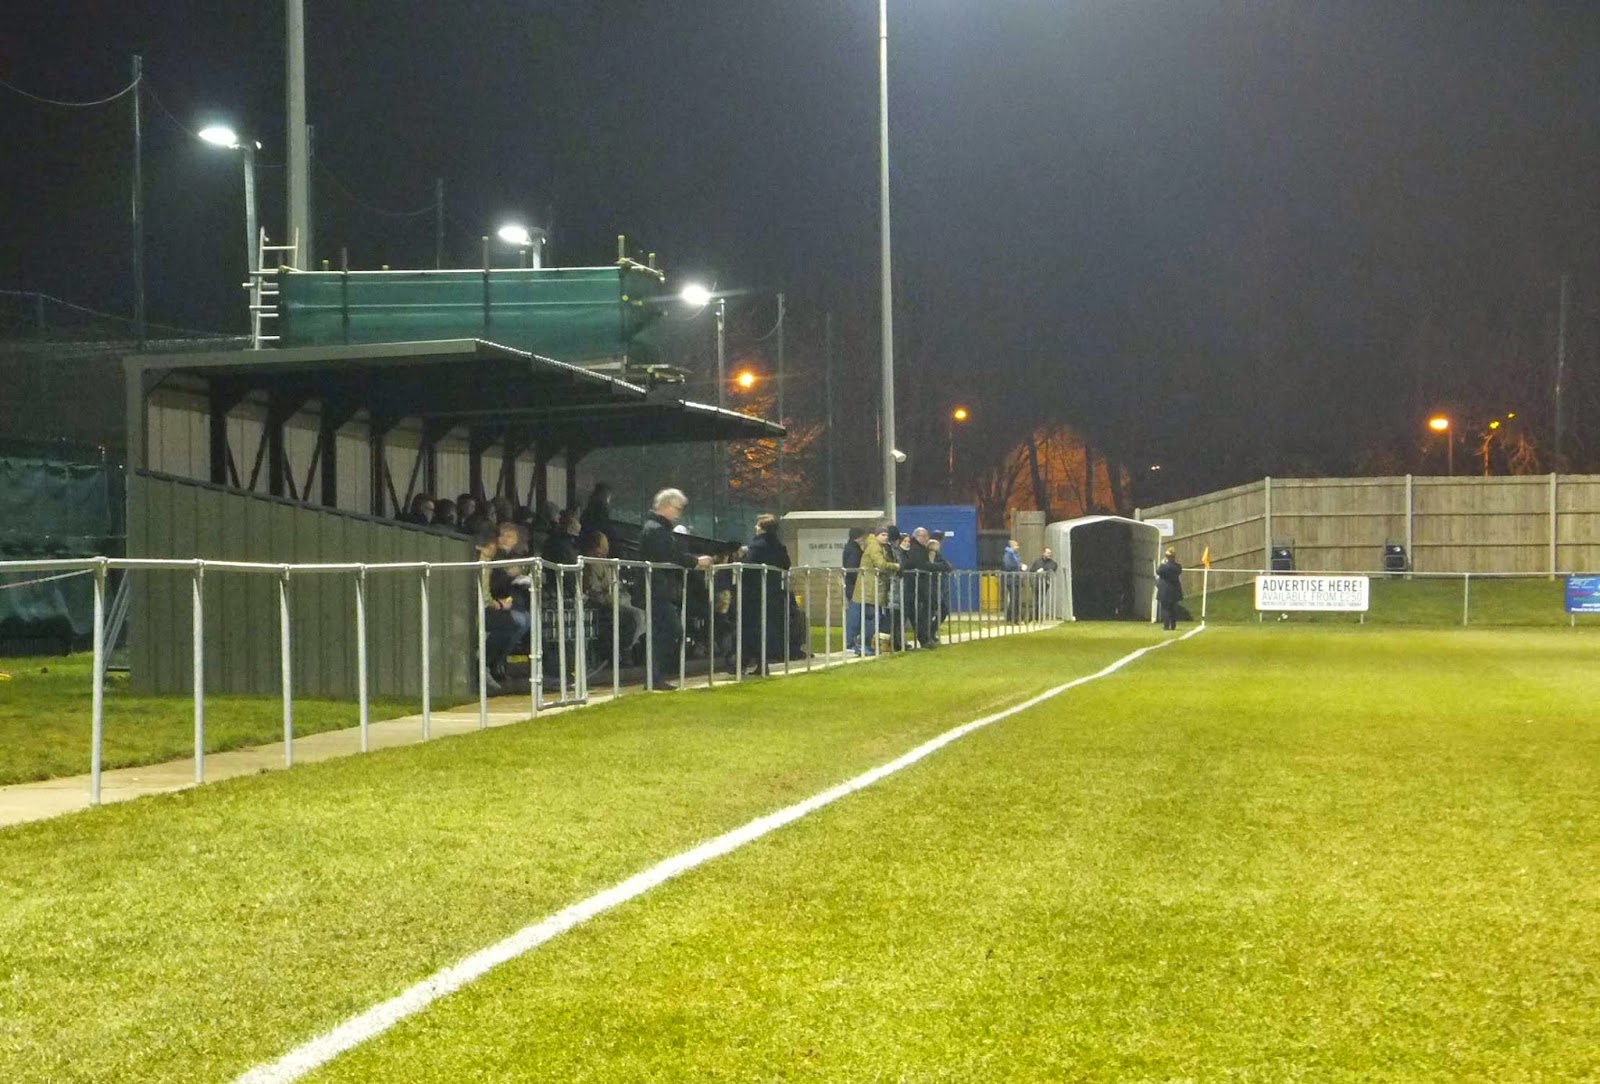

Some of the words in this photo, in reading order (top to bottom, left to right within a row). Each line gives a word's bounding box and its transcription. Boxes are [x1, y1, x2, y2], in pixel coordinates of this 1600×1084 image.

[1262, 579, 1324, 592] ADVERTISE
[1328, 579, 1362, 592] HERE!
[1261, 591, 1308, 602] AVAILABLE
[1311, 591, 1337, 602] FROM
